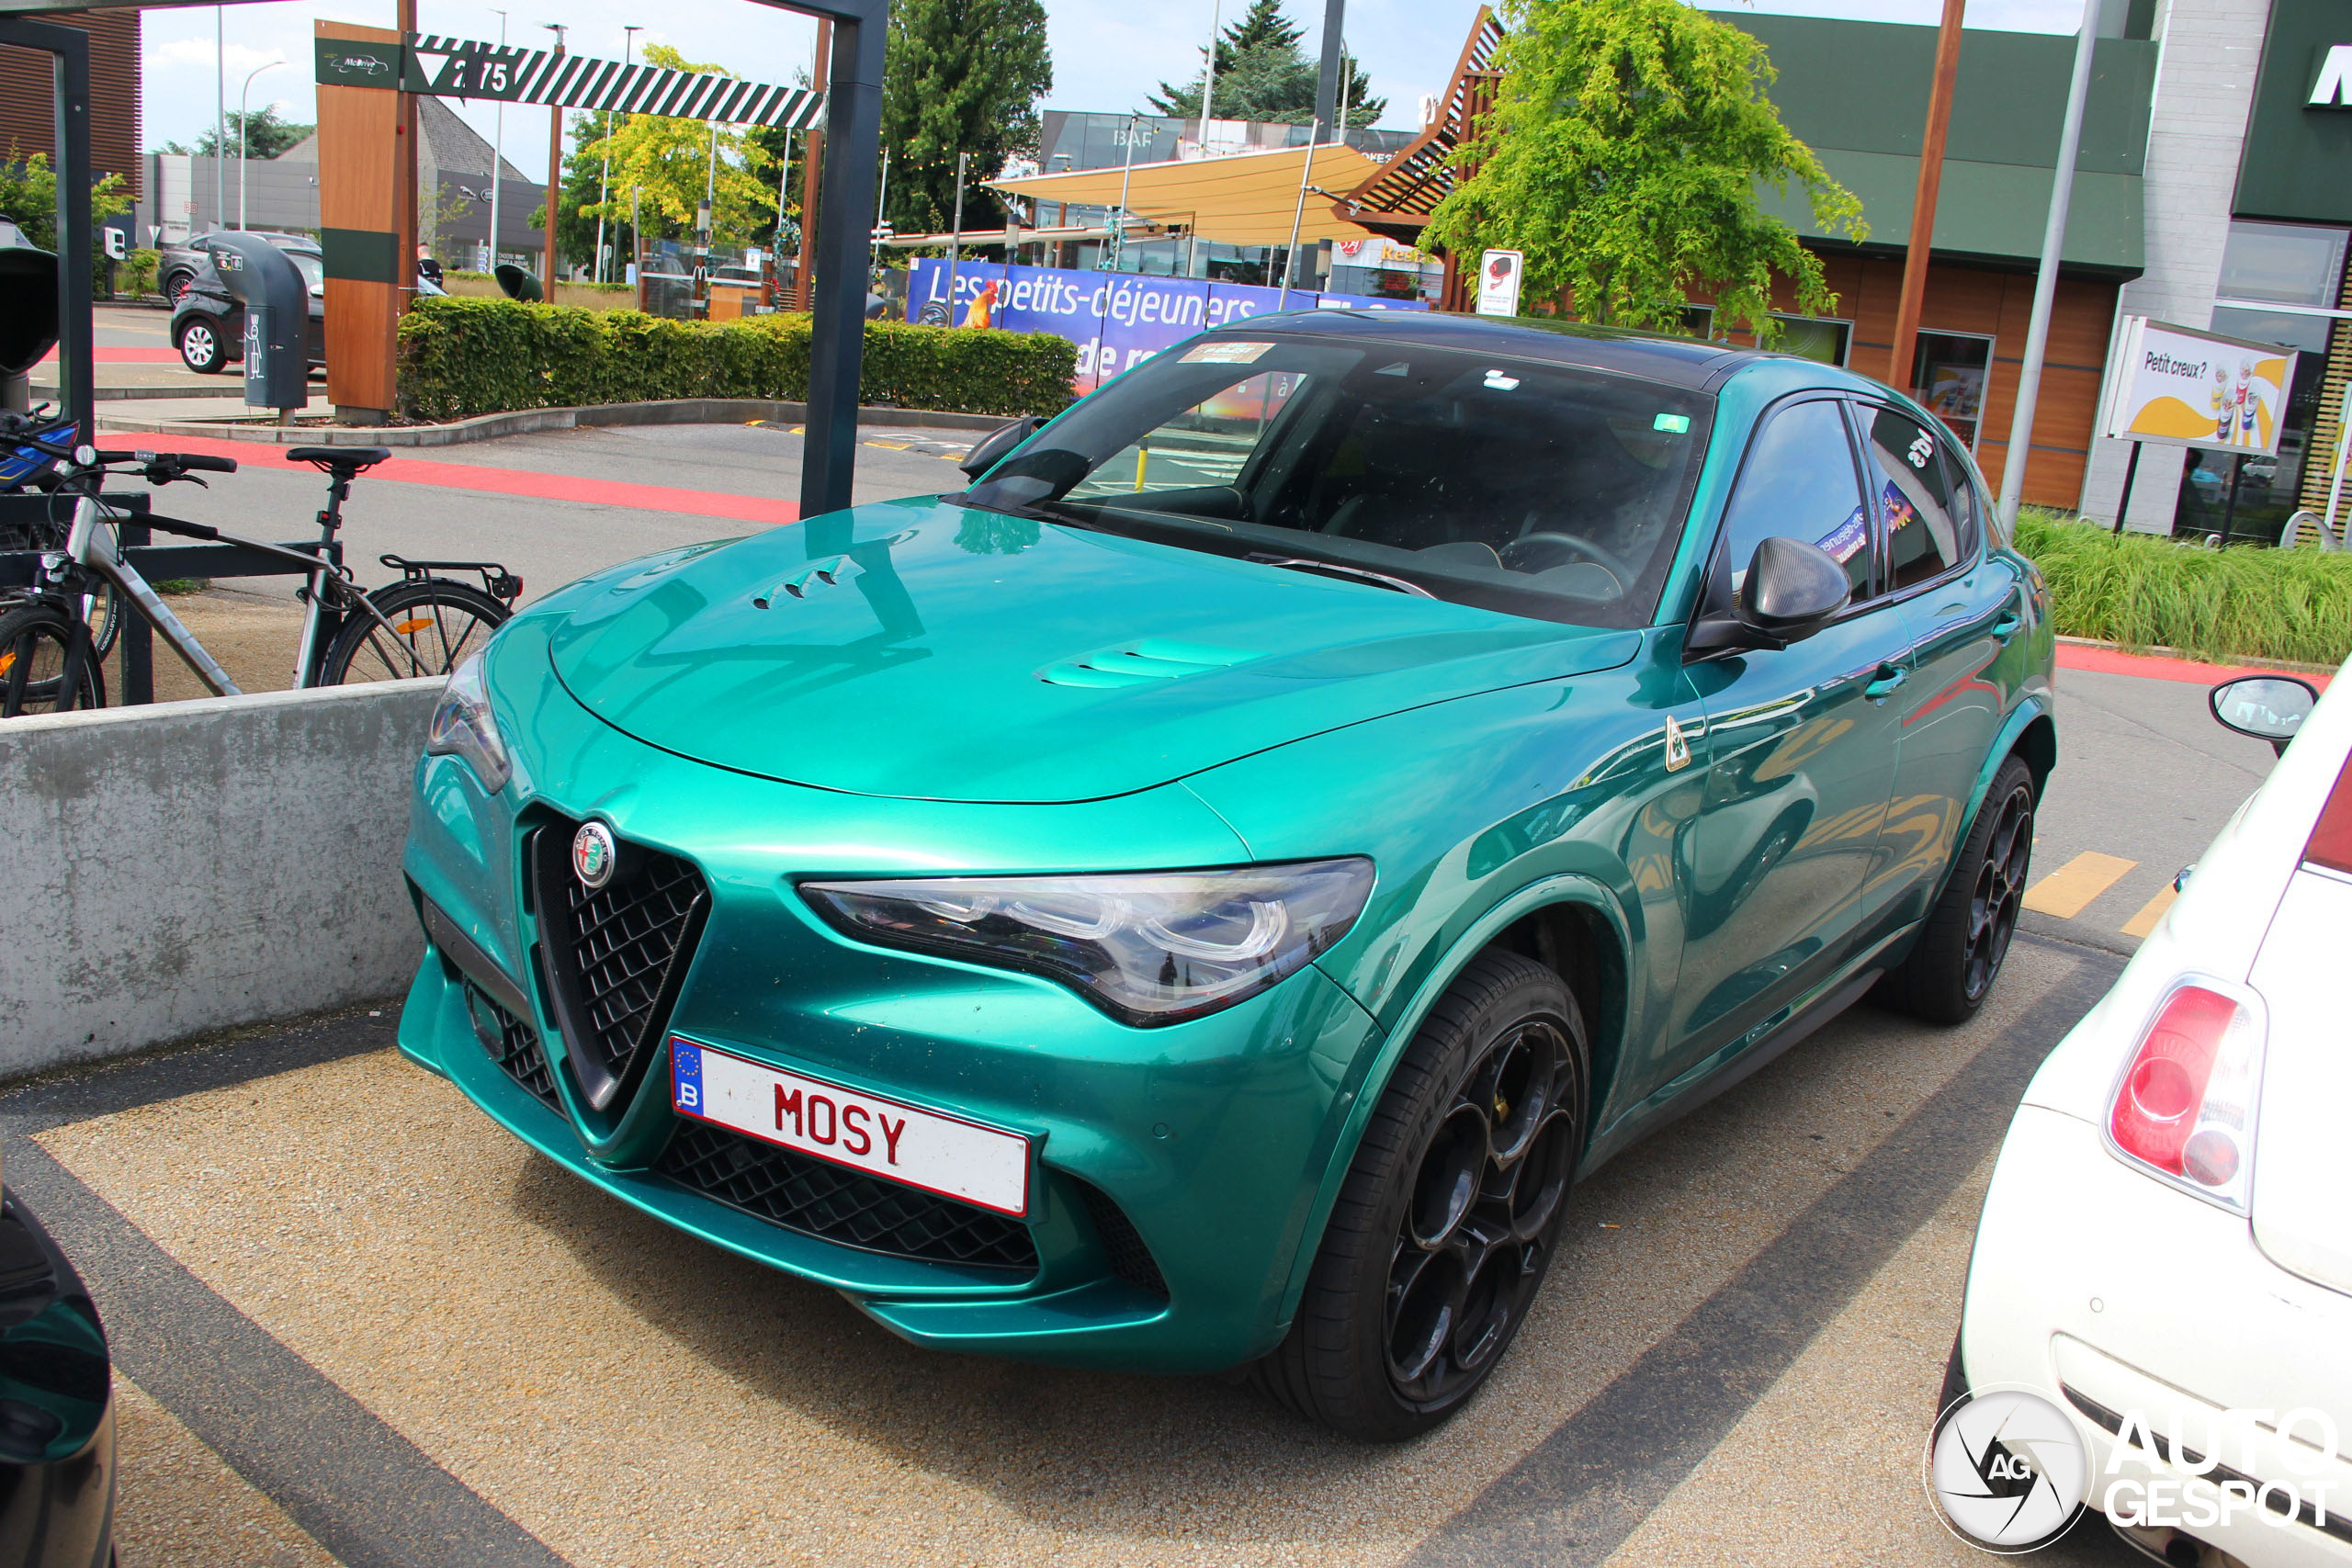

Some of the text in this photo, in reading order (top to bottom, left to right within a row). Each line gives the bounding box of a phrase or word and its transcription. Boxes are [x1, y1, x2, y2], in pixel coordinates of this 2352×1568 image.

[345, 57, 376, 68] McDrive
[929, 265, 1256, 327] Les petits-déjeuners
[1076, 337, 1117, 377] de
[2144, 351, 2170, 374] Petit
[681, 1082, 906, 1165] B MOSY
